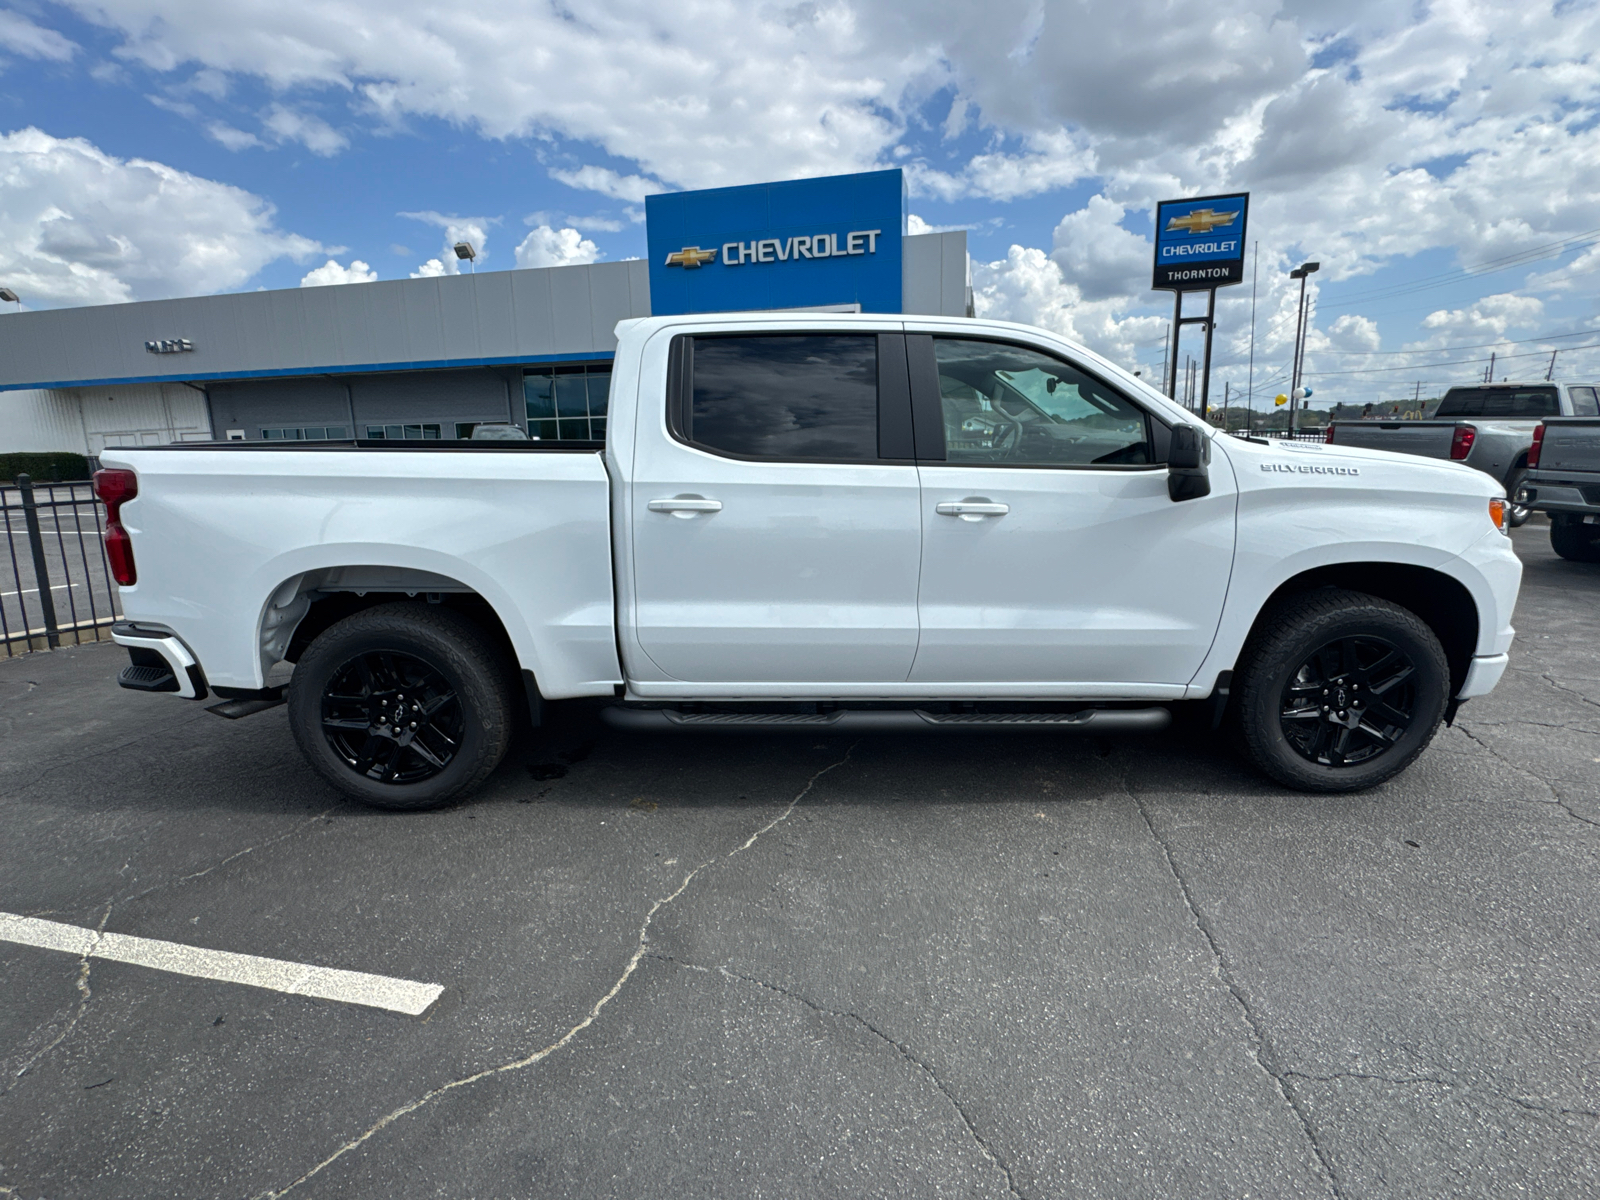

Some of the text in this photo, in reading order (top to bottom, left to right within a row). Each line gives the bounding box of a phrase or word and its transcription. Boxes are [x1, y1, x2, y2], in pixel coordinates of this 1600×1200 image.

[722, 229, 881, 266] CHEVROLET
[1162, 241, 1237, 257] CHEVROLET
[1168, 267, 1229, 280] THORNTON
[1260, 463, 1361, 476] SILVERADO
